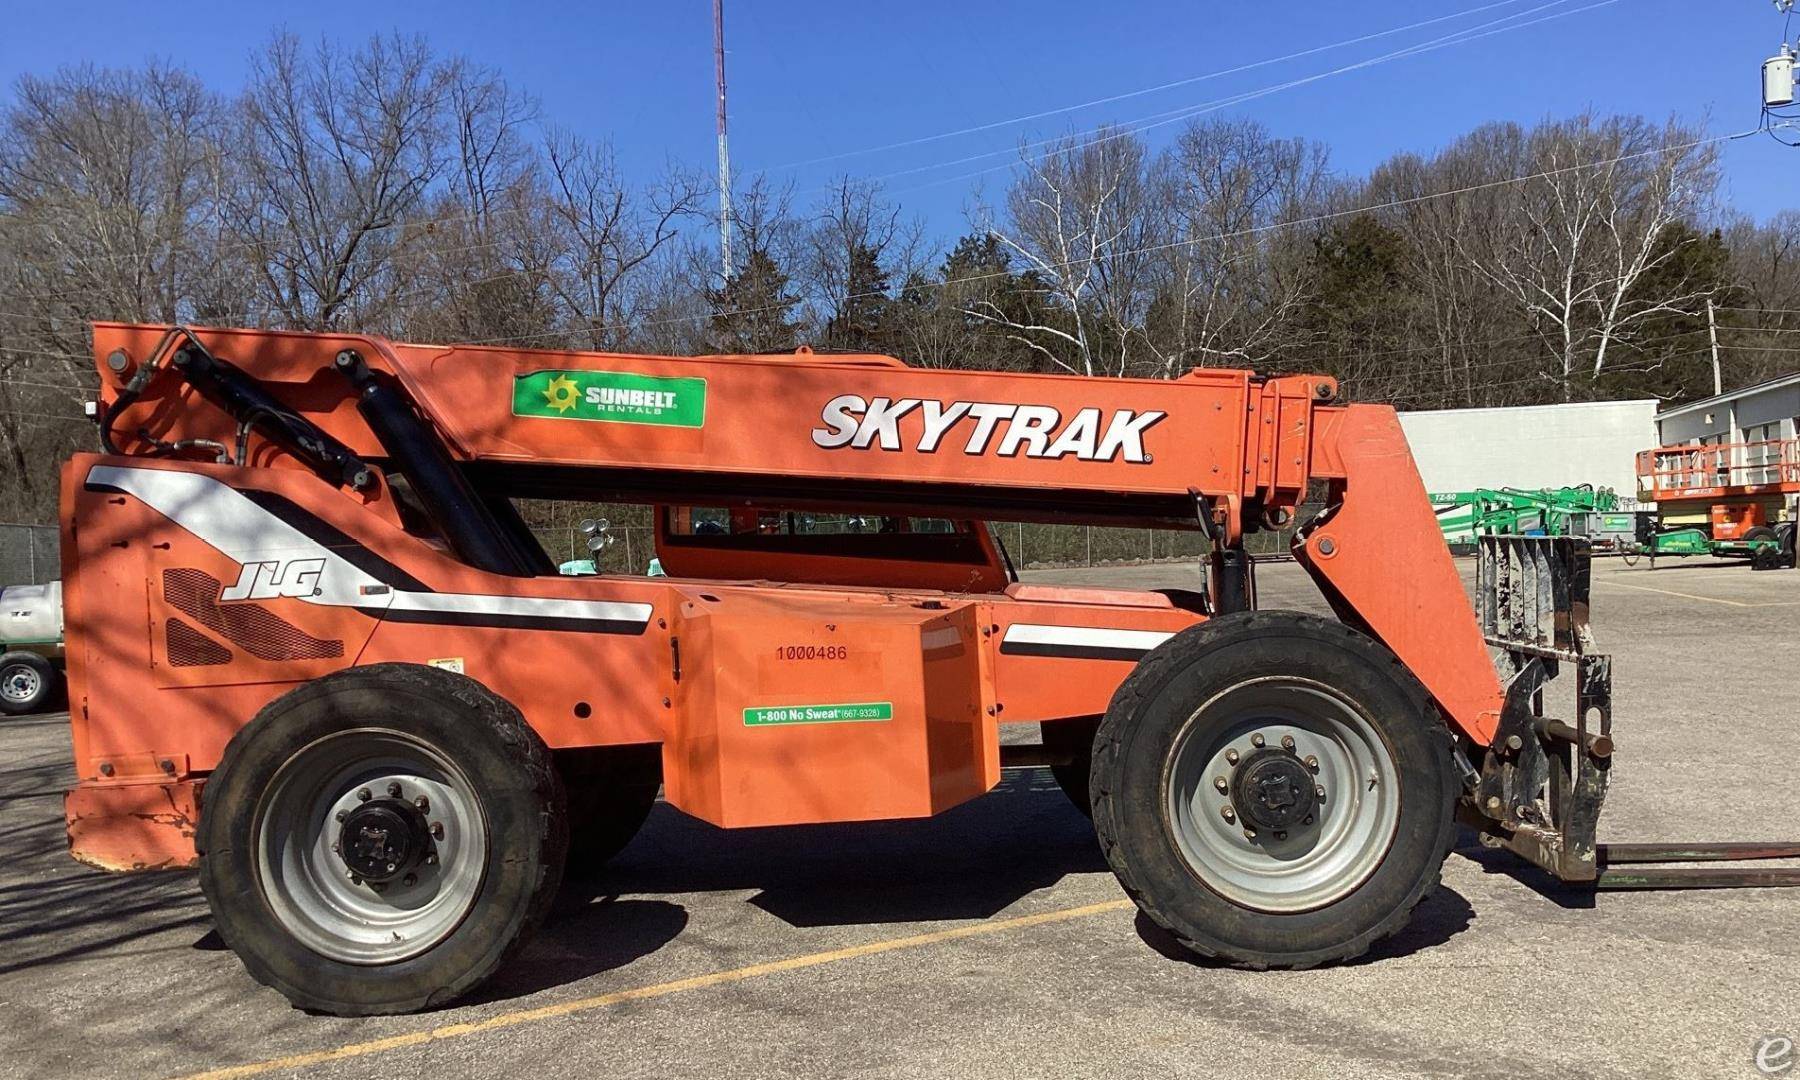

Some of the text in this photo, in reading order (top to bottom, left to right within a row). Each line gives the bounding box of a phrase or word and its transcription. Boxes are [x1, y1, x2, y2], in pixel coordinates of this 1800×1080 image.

[585, 387, 677, 408] SUNBELT
[597, 404, 662, 415] RENTALS
[811, 394, 1169, 464] SKYTRAK
[219, 558, 326, 602] JLG
[776, 646, 847, 660] 1000486
[756, 707, 880, 722] 1-800 No Sweat (667-9328)
